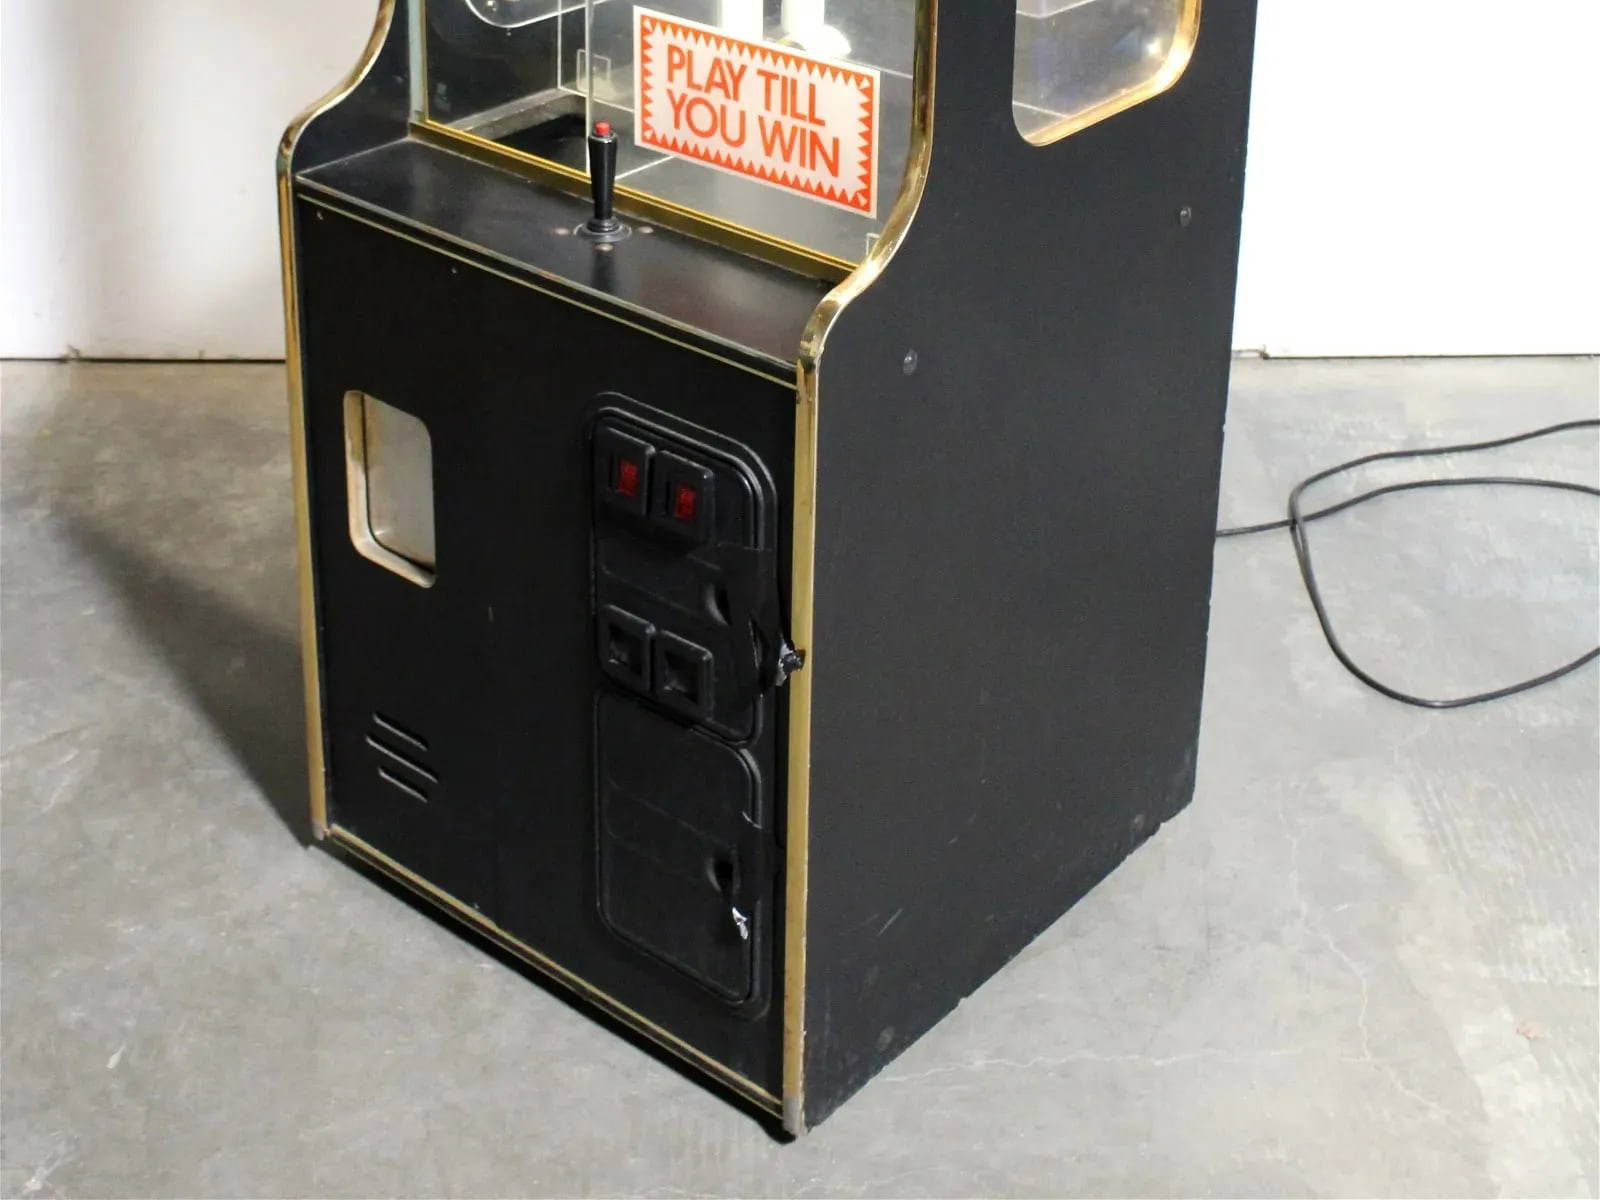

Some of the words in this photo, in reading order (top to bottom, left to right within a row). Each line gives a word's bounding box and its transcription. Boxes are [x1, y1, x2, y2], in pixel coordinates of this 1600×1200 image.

[666, 43, 747, 102] PLAY
[757, 68, 826, 127] TILL
[666, 88, 746, 148] YOU
[758, 114, 840, 178] WIN
